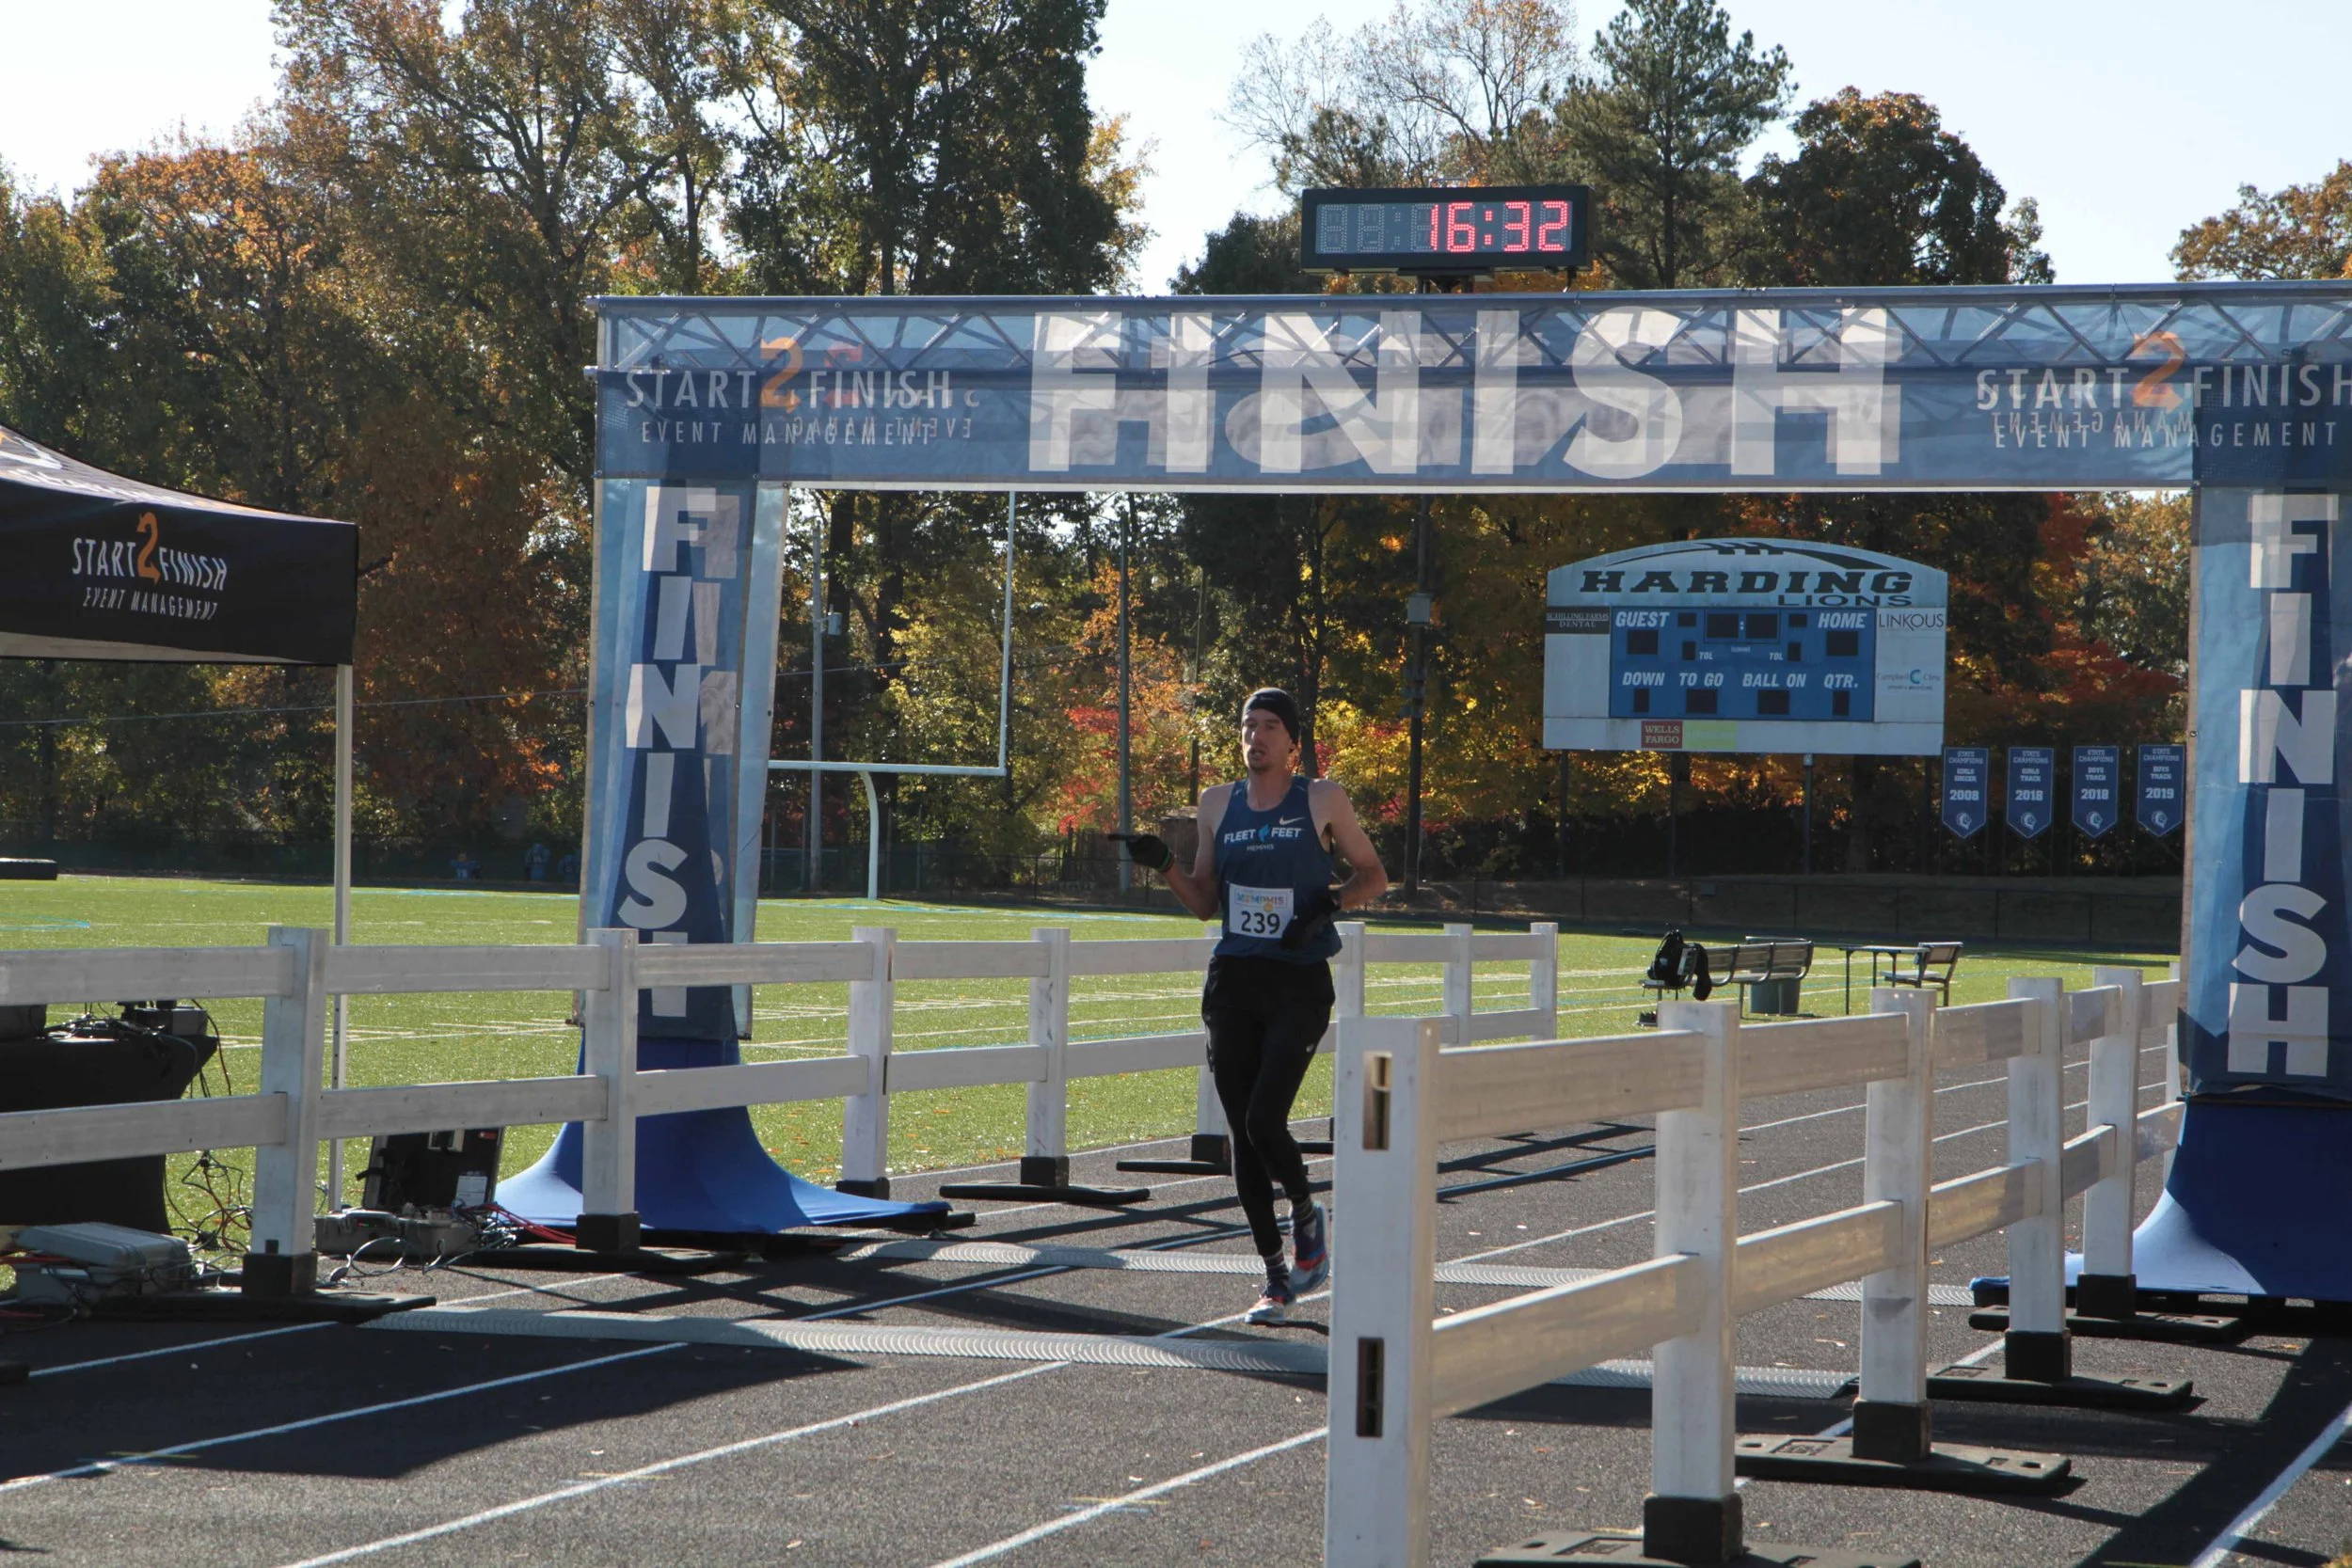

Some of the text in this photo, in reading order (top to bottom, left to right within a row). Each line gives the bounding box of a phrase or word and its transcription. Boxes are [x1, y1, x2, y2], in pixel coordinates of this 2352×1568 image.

[1429, 200, 1568, 253] 16:32
[1028, 306, 1887, 480] FINISH
[642, 420, 930, 445] EVENT MANAGEMENT
[1995, 421, 2336, 449] EVENT MANAGEMENT
[1580, 571, 1913, 594] HARDING
[83, 587, 218, 621] EVENT MANAGEMENT
[1777, 594, 1914, 607] LIONS
[1615, 611, 1670, 627] GUEST
[1818, 612, 1867, 629] HOME
[1879, 613, 1945, 631] LINKOUS
[1699, 652, 1713, 660] TOL
[1769, 652, 1784, 660] TOL
[1622, 672, 1665, 686] DOWN
[1679, 673, 1724, 687] TO GO
[1742, 673, 1806, 688] BALL ON
[1823, 673, 1858, 689] QTR.
[1645, 725, 1679, 734] WELLS
[2146, 787, 2174, 799] 2019
[2228, 494, 2339, 1077] FINISH
[2015, 789, 2043, 801] 2018
[2080, 788, 2109, 800] 2018
[1223, 827, 1302, 844] FLEET FEET
[1241, 911, 1280, 935] 239
